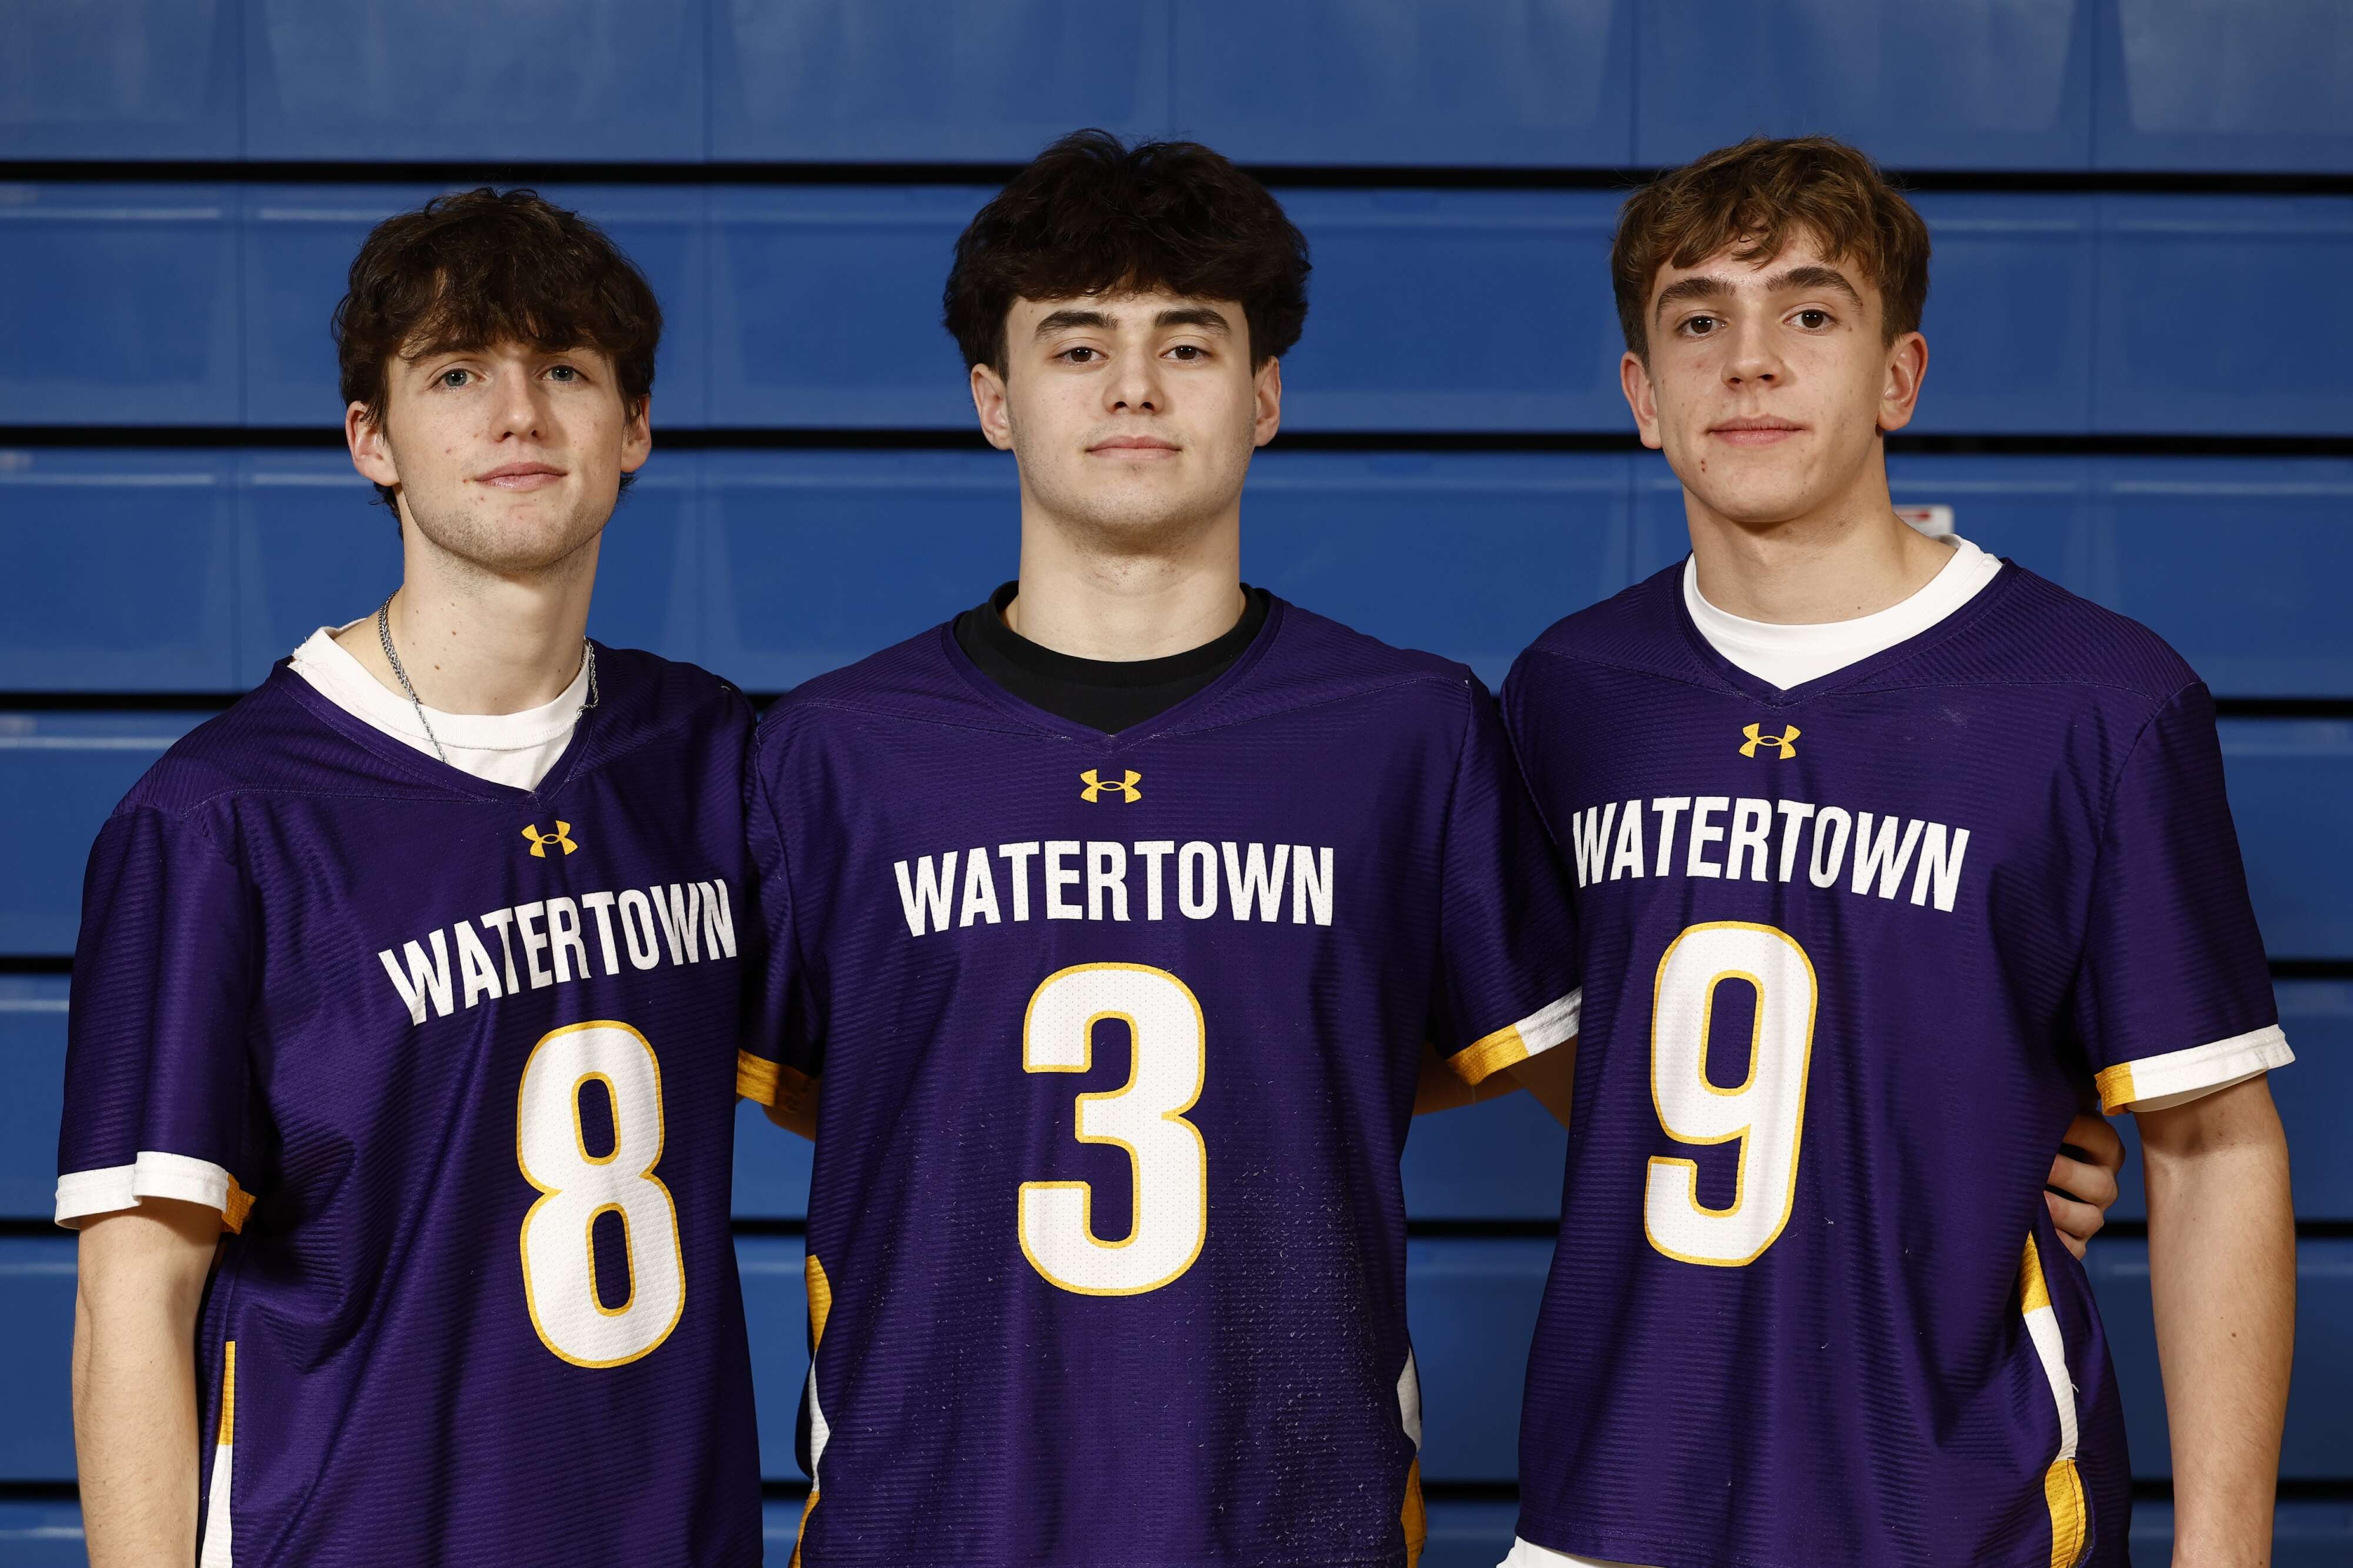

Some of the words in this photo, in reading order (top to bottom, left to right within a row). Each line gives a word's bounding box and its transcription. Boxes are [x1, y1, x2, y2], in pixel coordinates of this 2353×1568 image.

[378, 879, 737, 1026] WATERTOWN
[894, 840, 1334, 937] WATERTOWN
[1572, 796, 1971, 913] WATERTOWN
[516, 1020, 686, 1369] 8
[1018, 962, 1207, 1296] 3
[1644, 920, 1818, 1267] 9
